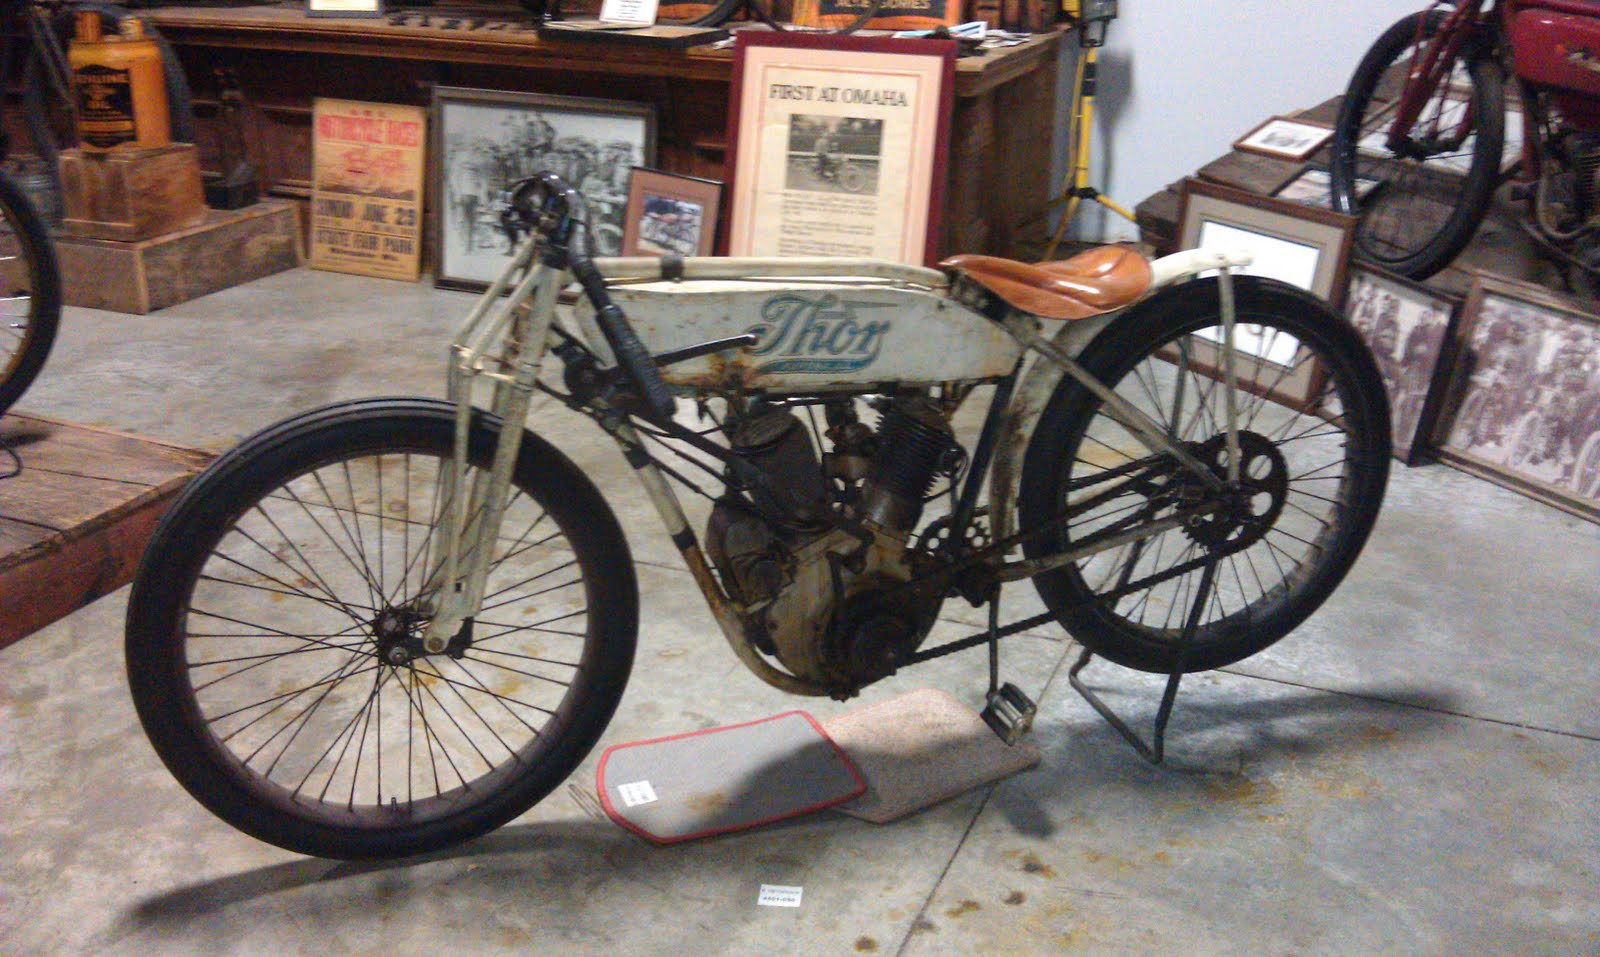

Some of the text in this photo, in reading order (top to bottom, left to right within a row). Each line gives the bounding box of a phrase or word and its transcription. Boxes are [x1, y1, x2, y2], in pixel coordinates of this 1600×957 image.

[769, 83, 909, 106] FIRST AT OMAHA
[745, 292, 893, 359] Thor
